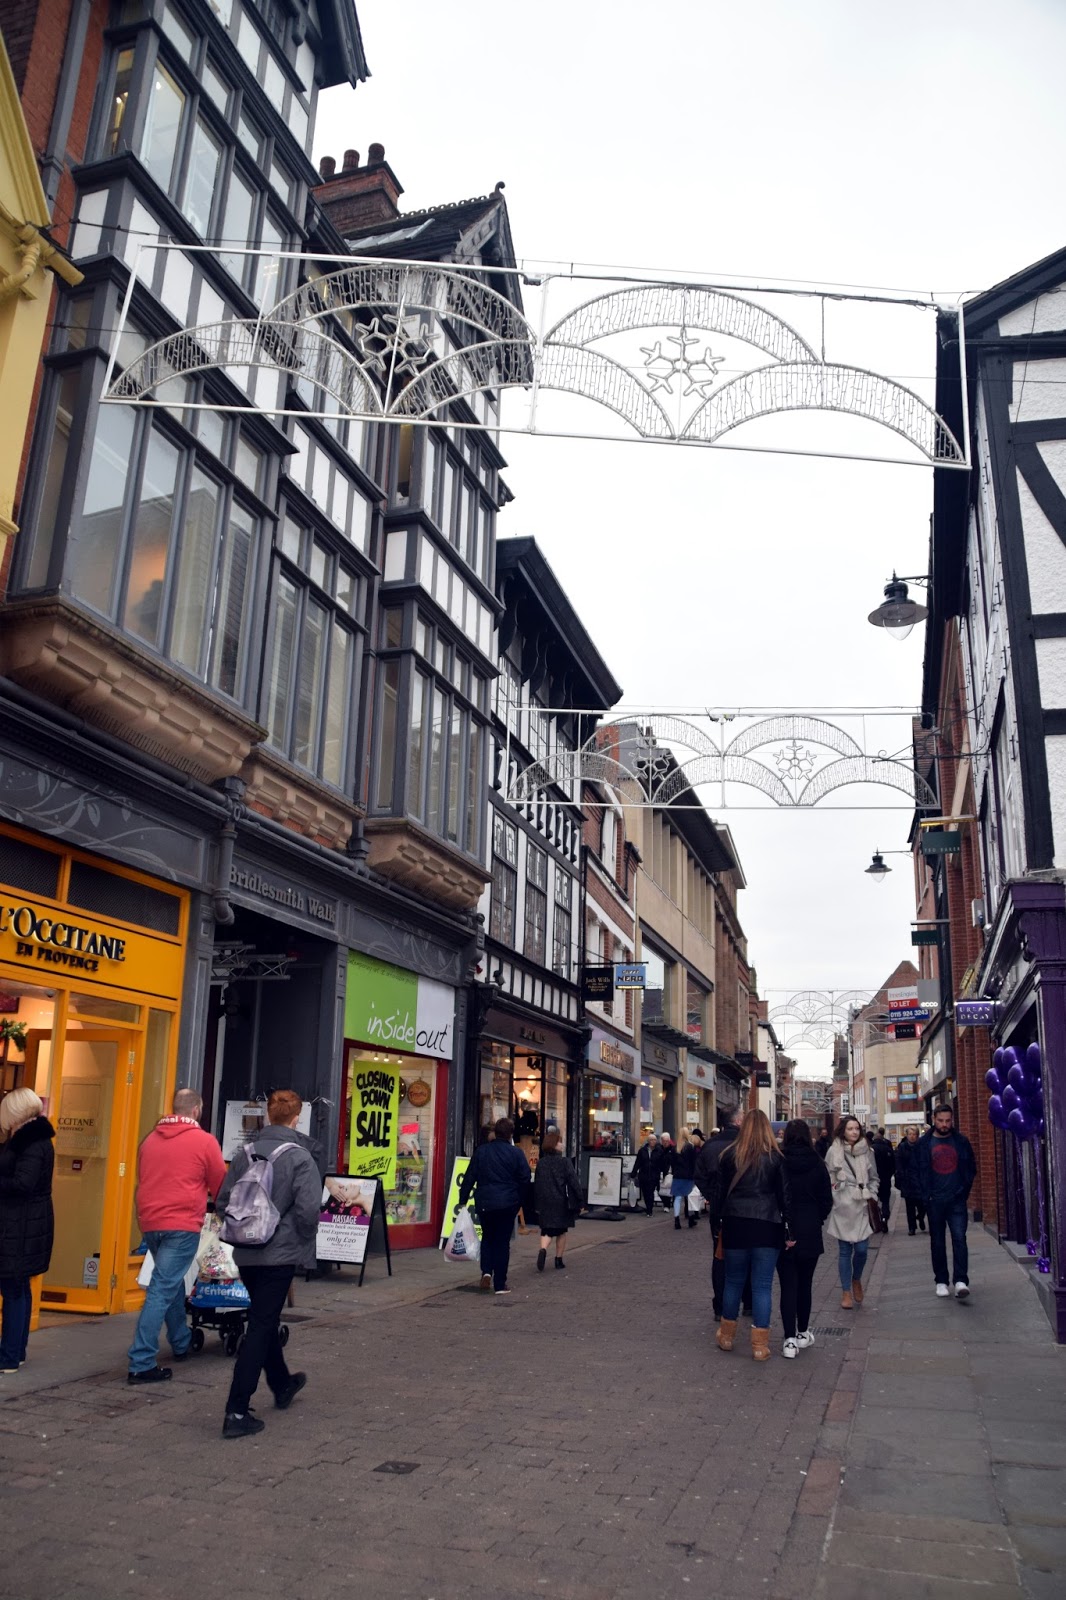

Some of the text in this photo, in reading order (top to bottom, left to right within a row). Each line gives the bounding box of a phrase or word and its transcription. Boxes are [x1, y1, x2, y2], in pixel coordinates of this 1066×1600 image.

[229, 863, 336, 923] Bridlesmith Walk
[16, 942, 99, 971] EN PROVENCE
[585, 976, 596, 985] Jack
[617, 975, 644, 983] NERO
[959, 1006, 990, 1014] URBAN
[367, 1001, 448, 1053] inside out
[356, 1070, 395, 1094] CLOSING
[360, 1088, 391, 1110] DOWN
[58, 1117, 94, 1127] CCITANE
[158, 1115, 178, 1125] tréal
[356, 1110, 392, 1148] SALE
[357, 1156, 385, 1171] ALL STOCK
[360, 1164, 376, 1175] MUST
[331, 1214, 357, 1225] MASSAGE
[327, 1235, 342, 1243] only
[204, 1284, 249, 1299] Entertai
